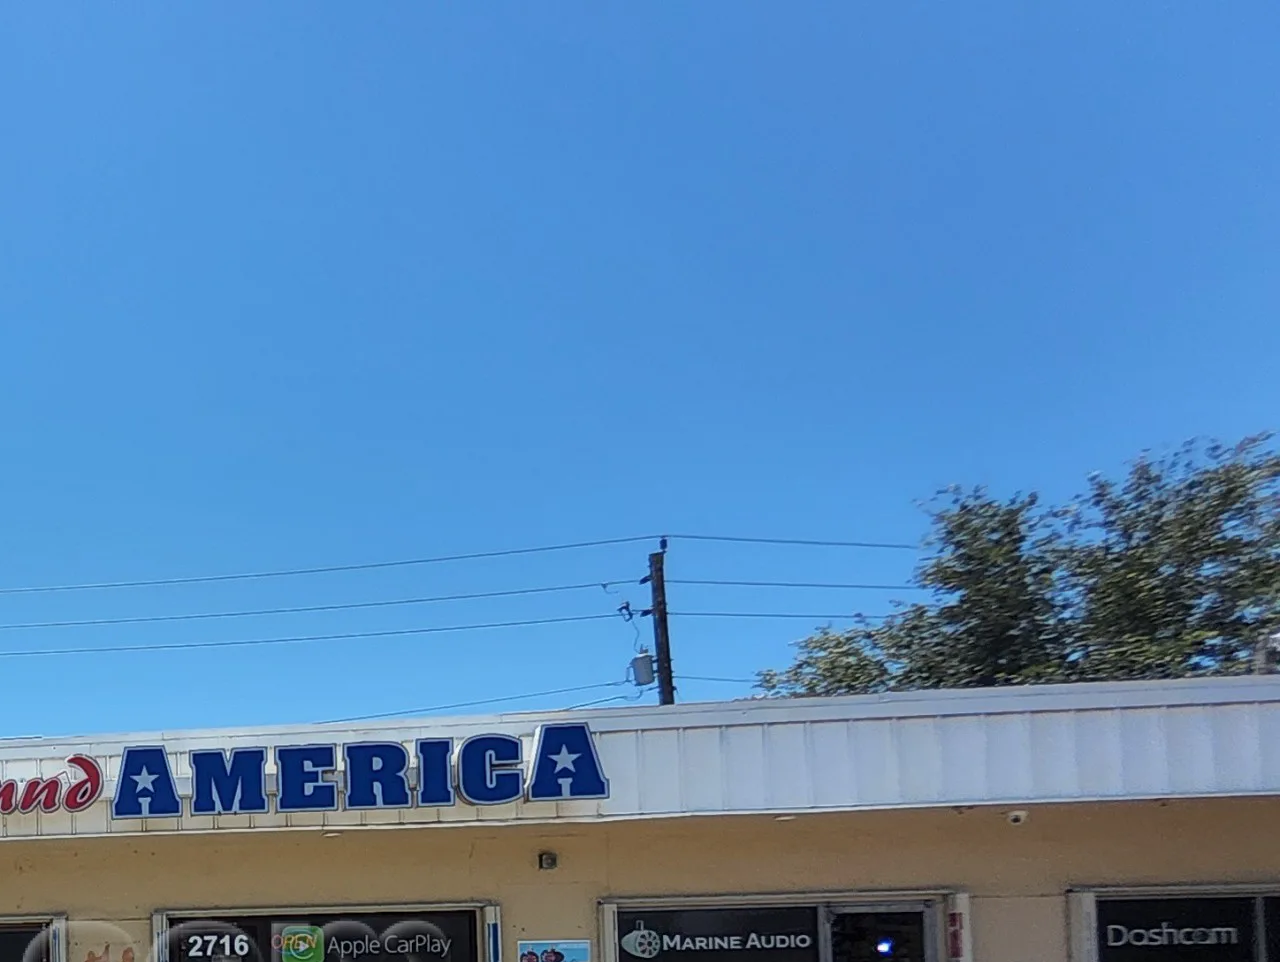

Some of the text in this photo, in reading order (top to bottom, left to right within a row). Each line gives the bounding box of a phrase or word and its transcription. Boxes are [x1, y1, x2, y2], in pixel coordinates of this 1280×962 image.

[111, 722, 610, 822] AMERICA
[187, 934, 250, 958] 2716
[271, 934, 318, 951] OPEN
[327, 933, 452, 959] Apple CarPlay
[662, 931, 812, 951] MARINE AUDIO
